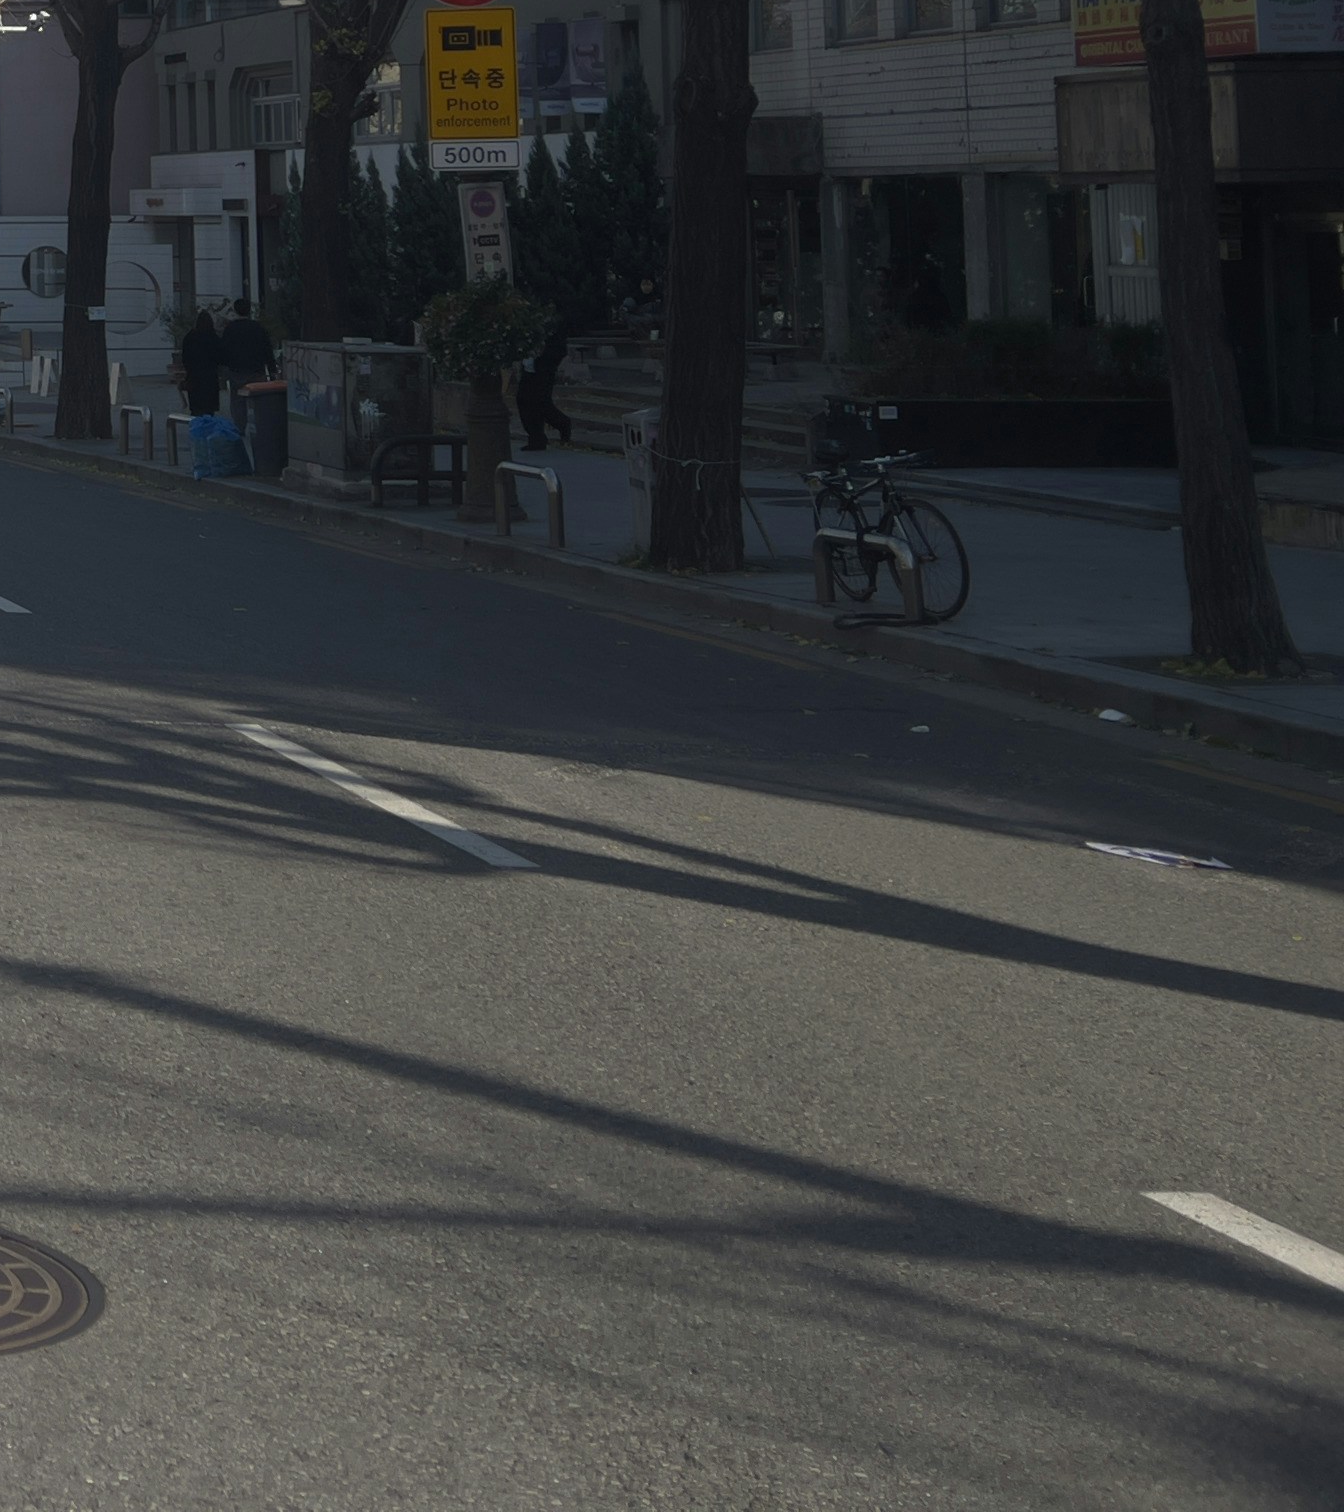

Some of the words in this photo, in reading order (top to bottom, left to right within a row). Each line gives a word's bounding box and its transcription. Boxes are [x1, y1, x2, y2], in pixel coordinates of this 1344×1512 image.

[438, 68, 505, 90] 단속중
[446, 97, 499, 112] Photo
[436, 113, 511, 129] enforcement
[444, 146, 507, 164] 500m
